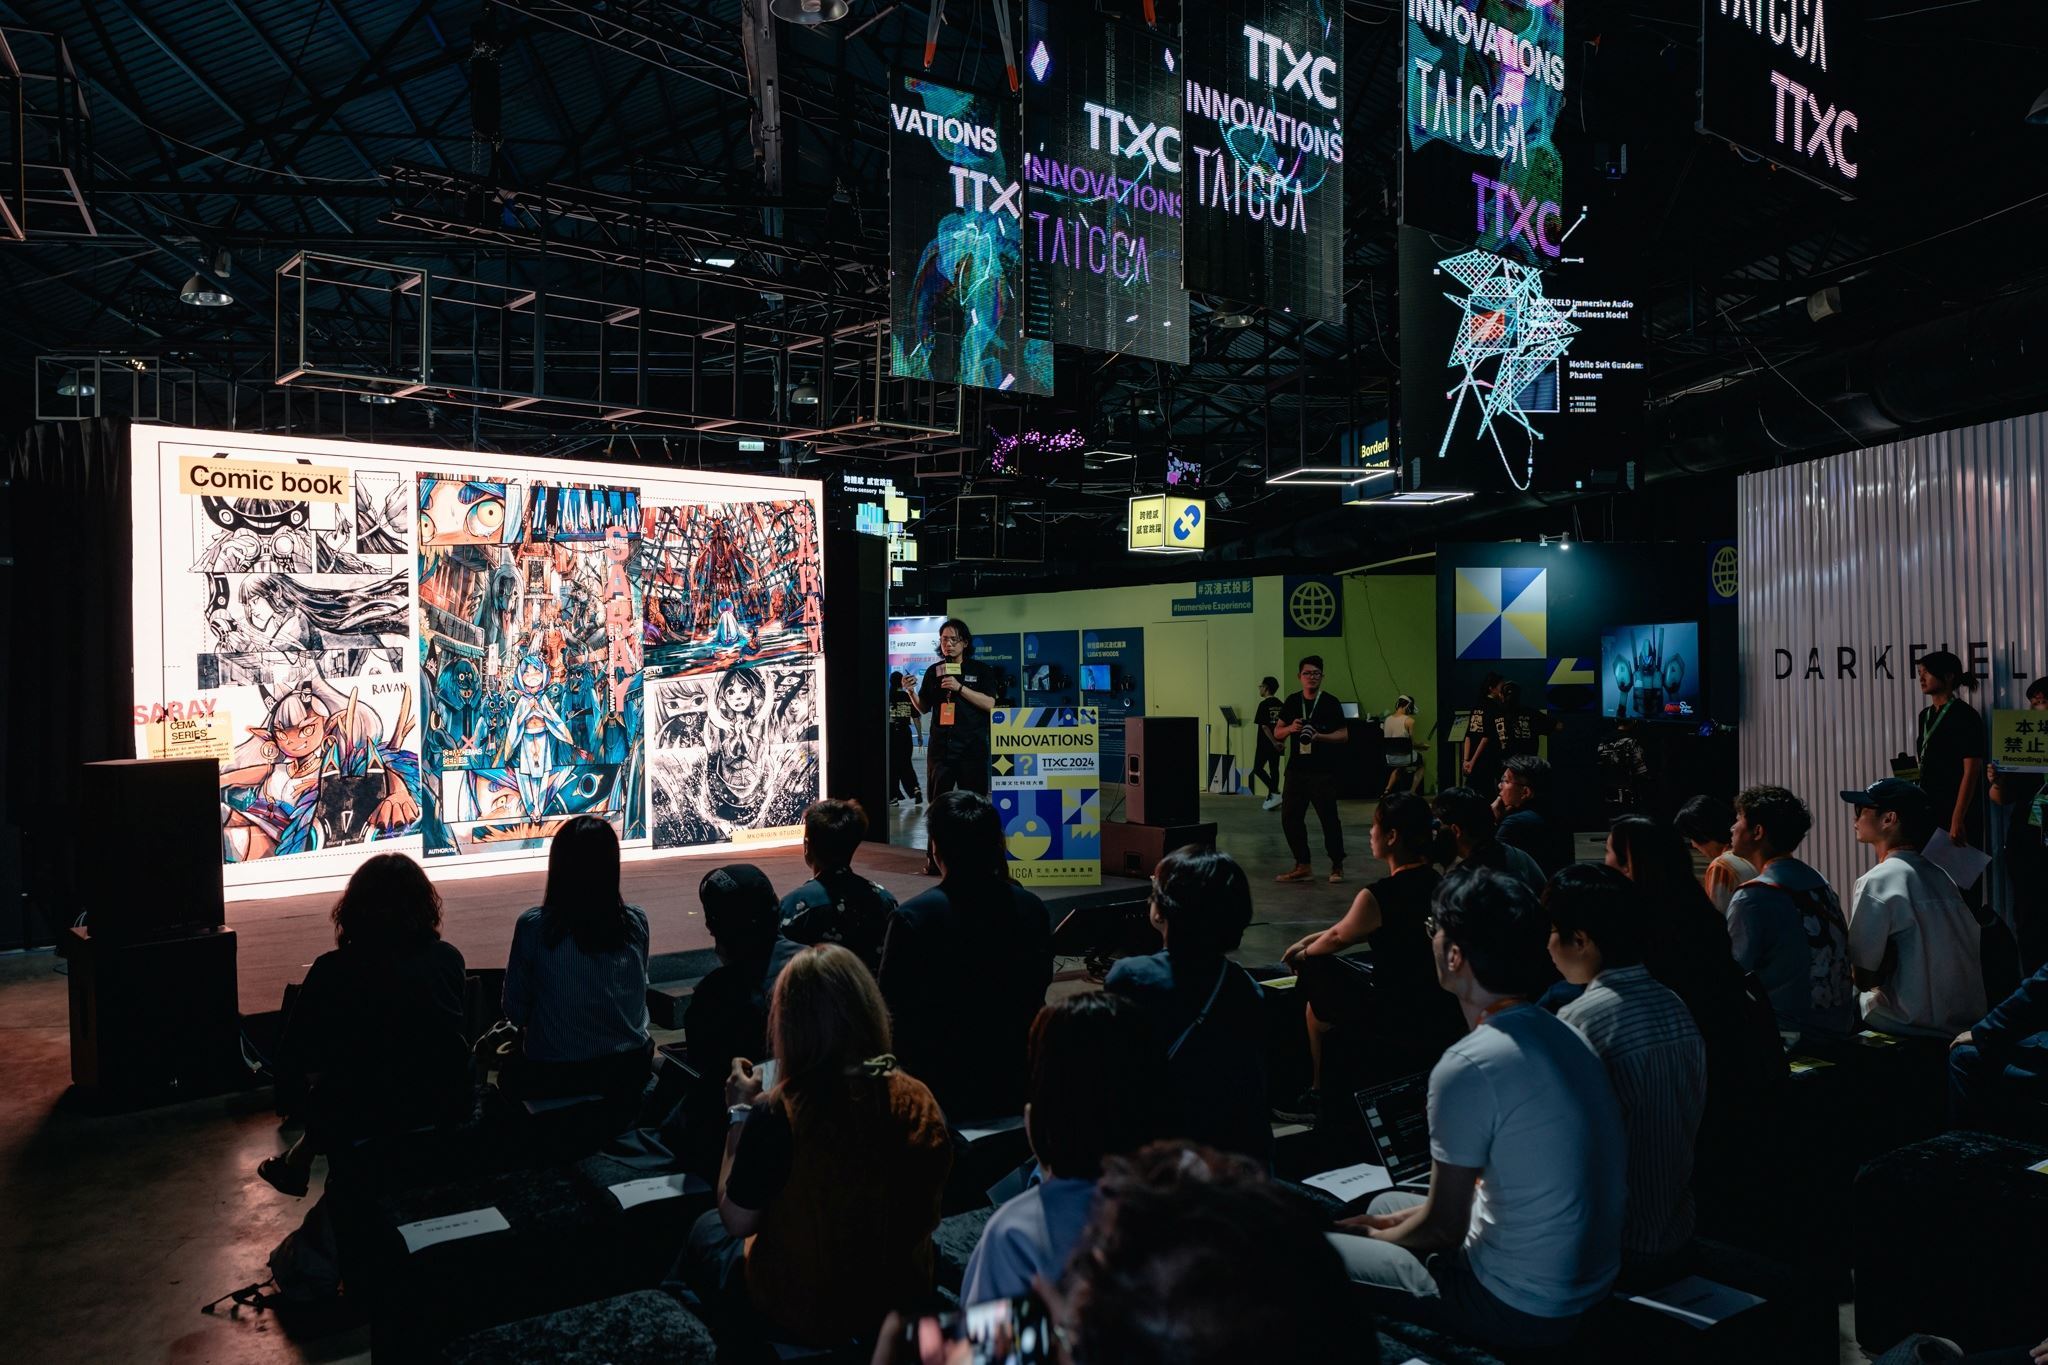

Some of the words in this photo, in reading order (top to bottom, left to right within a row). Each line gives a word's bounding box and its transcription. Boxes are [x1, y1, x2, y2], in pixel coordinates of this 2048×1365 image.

[1720, 0, 1827, 72] CCA
[1243, 24, 1337, 109] TTXC
[1186, 79, 1344, 163] INNOVATIONS
[1415, 57, 1528, 170] TAICCA
[891, 103, 998, 153] VATIONS
[1770, 70, 1858, 179] TTXC
[1083, 101, 1181, 173] TTXC
[949, 165, 1023, 220] TTX
[1193, 145, 1307, 234] TAICCA
[1471, 172, 1561, 258] TTXC
[1029, 211, 1150, 284] TAICCA
[1572, 299, 1610, 308] Immersive
[1612, 300, 1634, 309] Audio
[1572, 310, 1604, 319] Business
[1606, 311, 1629, 319] Model
[1569, 360, 1594, 369] Mobile
[1595, 361, 1610, 369] Suit
[1569, 371, 1603, 379] Phantom
[1361, 437, 1390, 458] Borderl
[189, 465, 274, 491] Comic
[282, 471, 343, 495] book
[843, 486, 878, 495] Cross-sensory
[878, 488, 904, 496] Rence
[1173, 602, 1212, 612] #Immersive
[1212, 600, 1251, 612] Experience
[1775, 641, 2028, 680] DARKFEL
[171, 729, 208, 741] SERIES
[995, 733, 1094, 748] INNOVATIONS
[2003, 737, 2046, 754] 禁止
[1041, 758, 1068, 768] TTXC
[1069, 757, 1095, 767] 2024
[2002, 755, 2042, 764] Recording
[779, 829, 802, 838] STUDIO
[1011, 867, 1033, 879] ICCA
